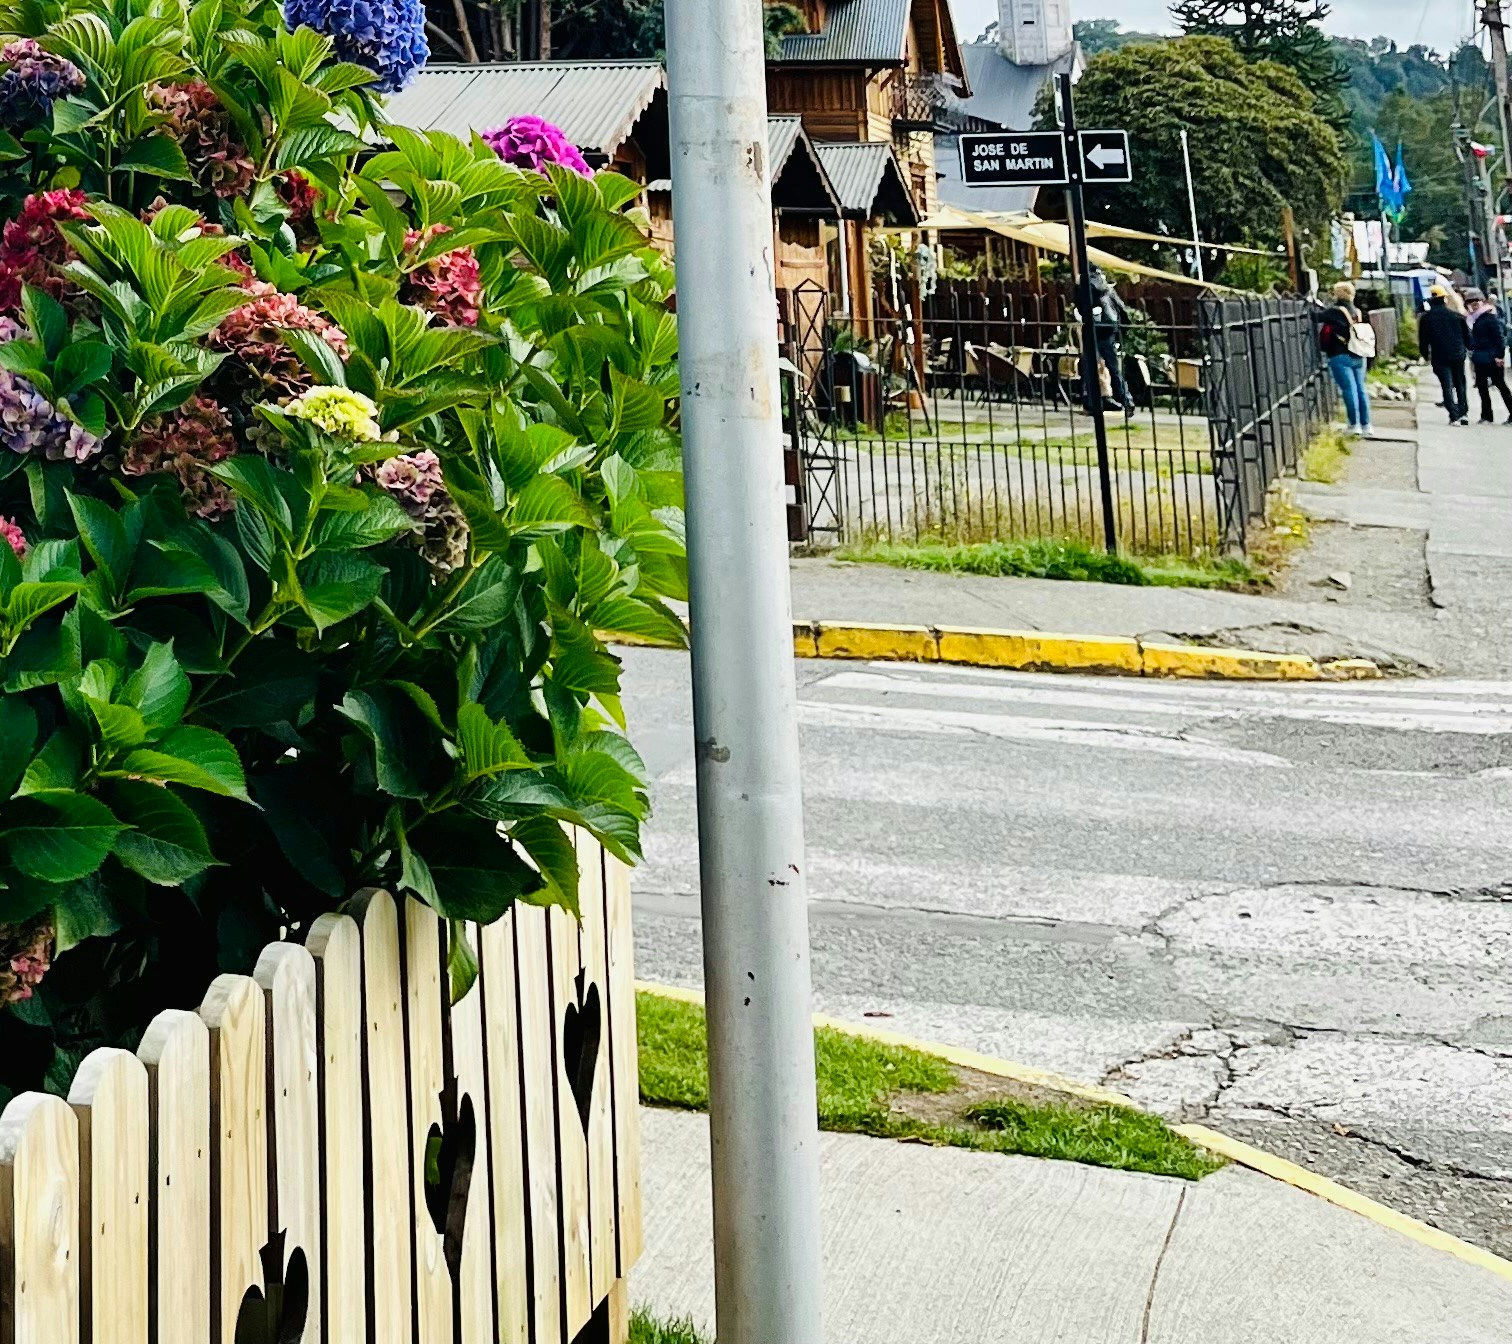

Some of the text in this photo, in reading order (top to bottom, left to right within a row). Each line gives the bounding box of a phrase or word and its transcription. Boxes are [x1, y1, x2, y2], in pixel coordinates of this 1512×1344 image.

[972, 142, 1028, 156] JOSE DE
[973, 157, 1054, 171] SAN MARTIN
